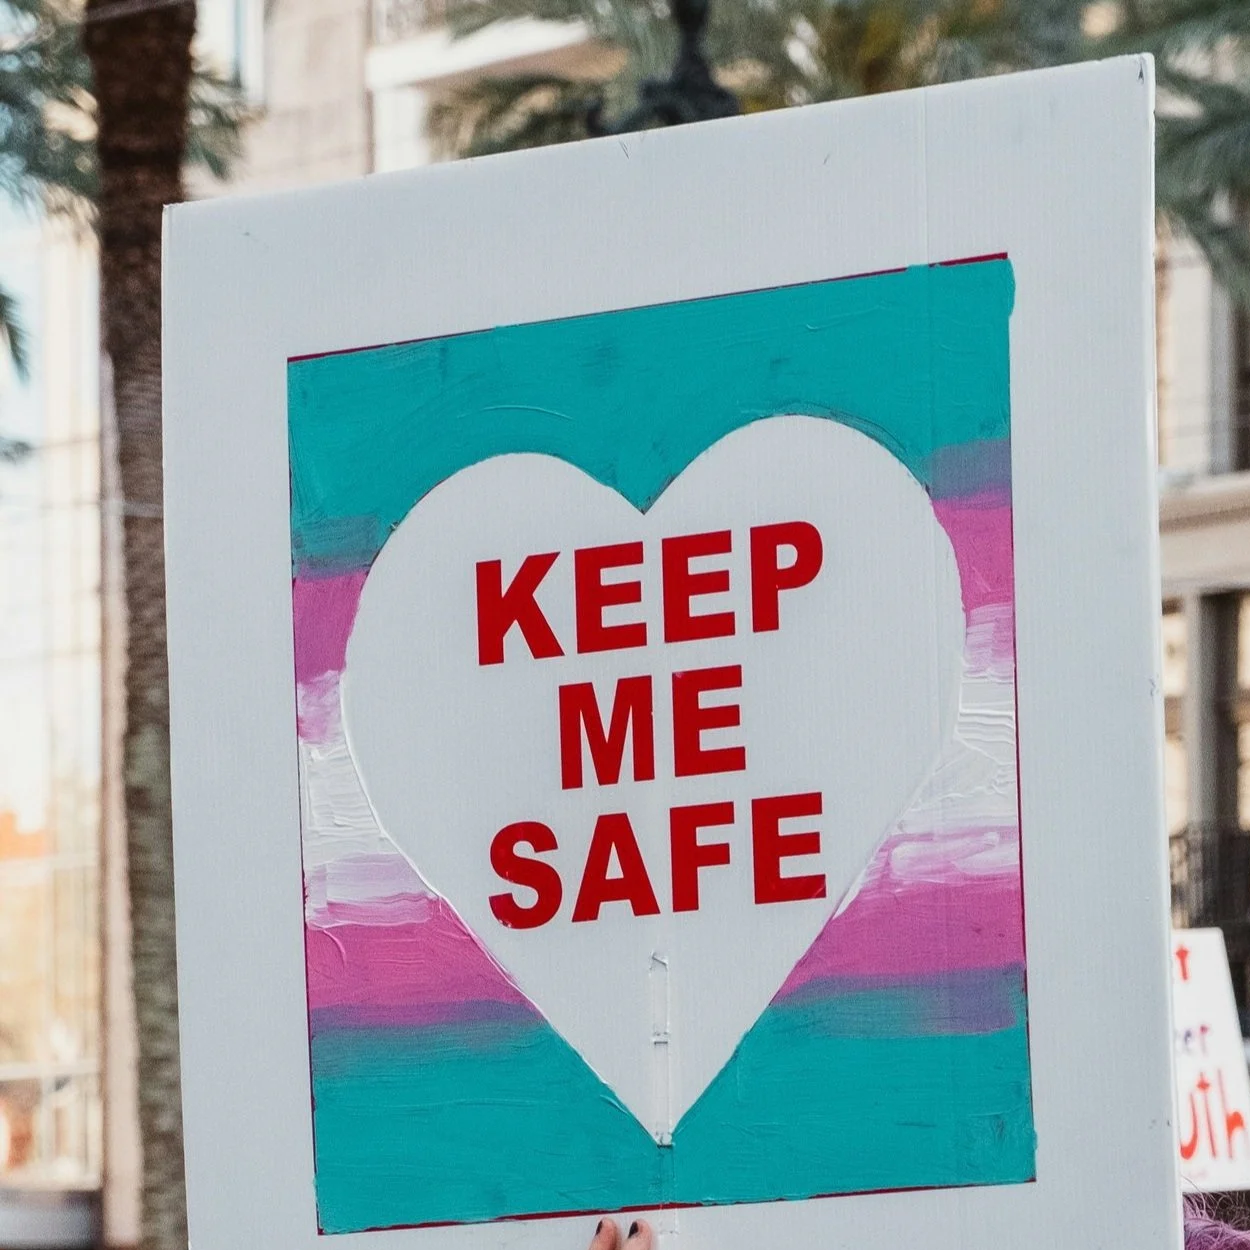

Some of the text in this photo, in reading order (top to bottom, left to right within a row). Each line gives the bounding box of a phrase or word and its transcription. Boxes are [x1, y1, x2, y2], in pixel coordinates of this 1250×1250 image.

[475, 520, 824, 666] KEEP
[558, 664, 747, 790] ME
[488, 791, 827, 930] SAFE
